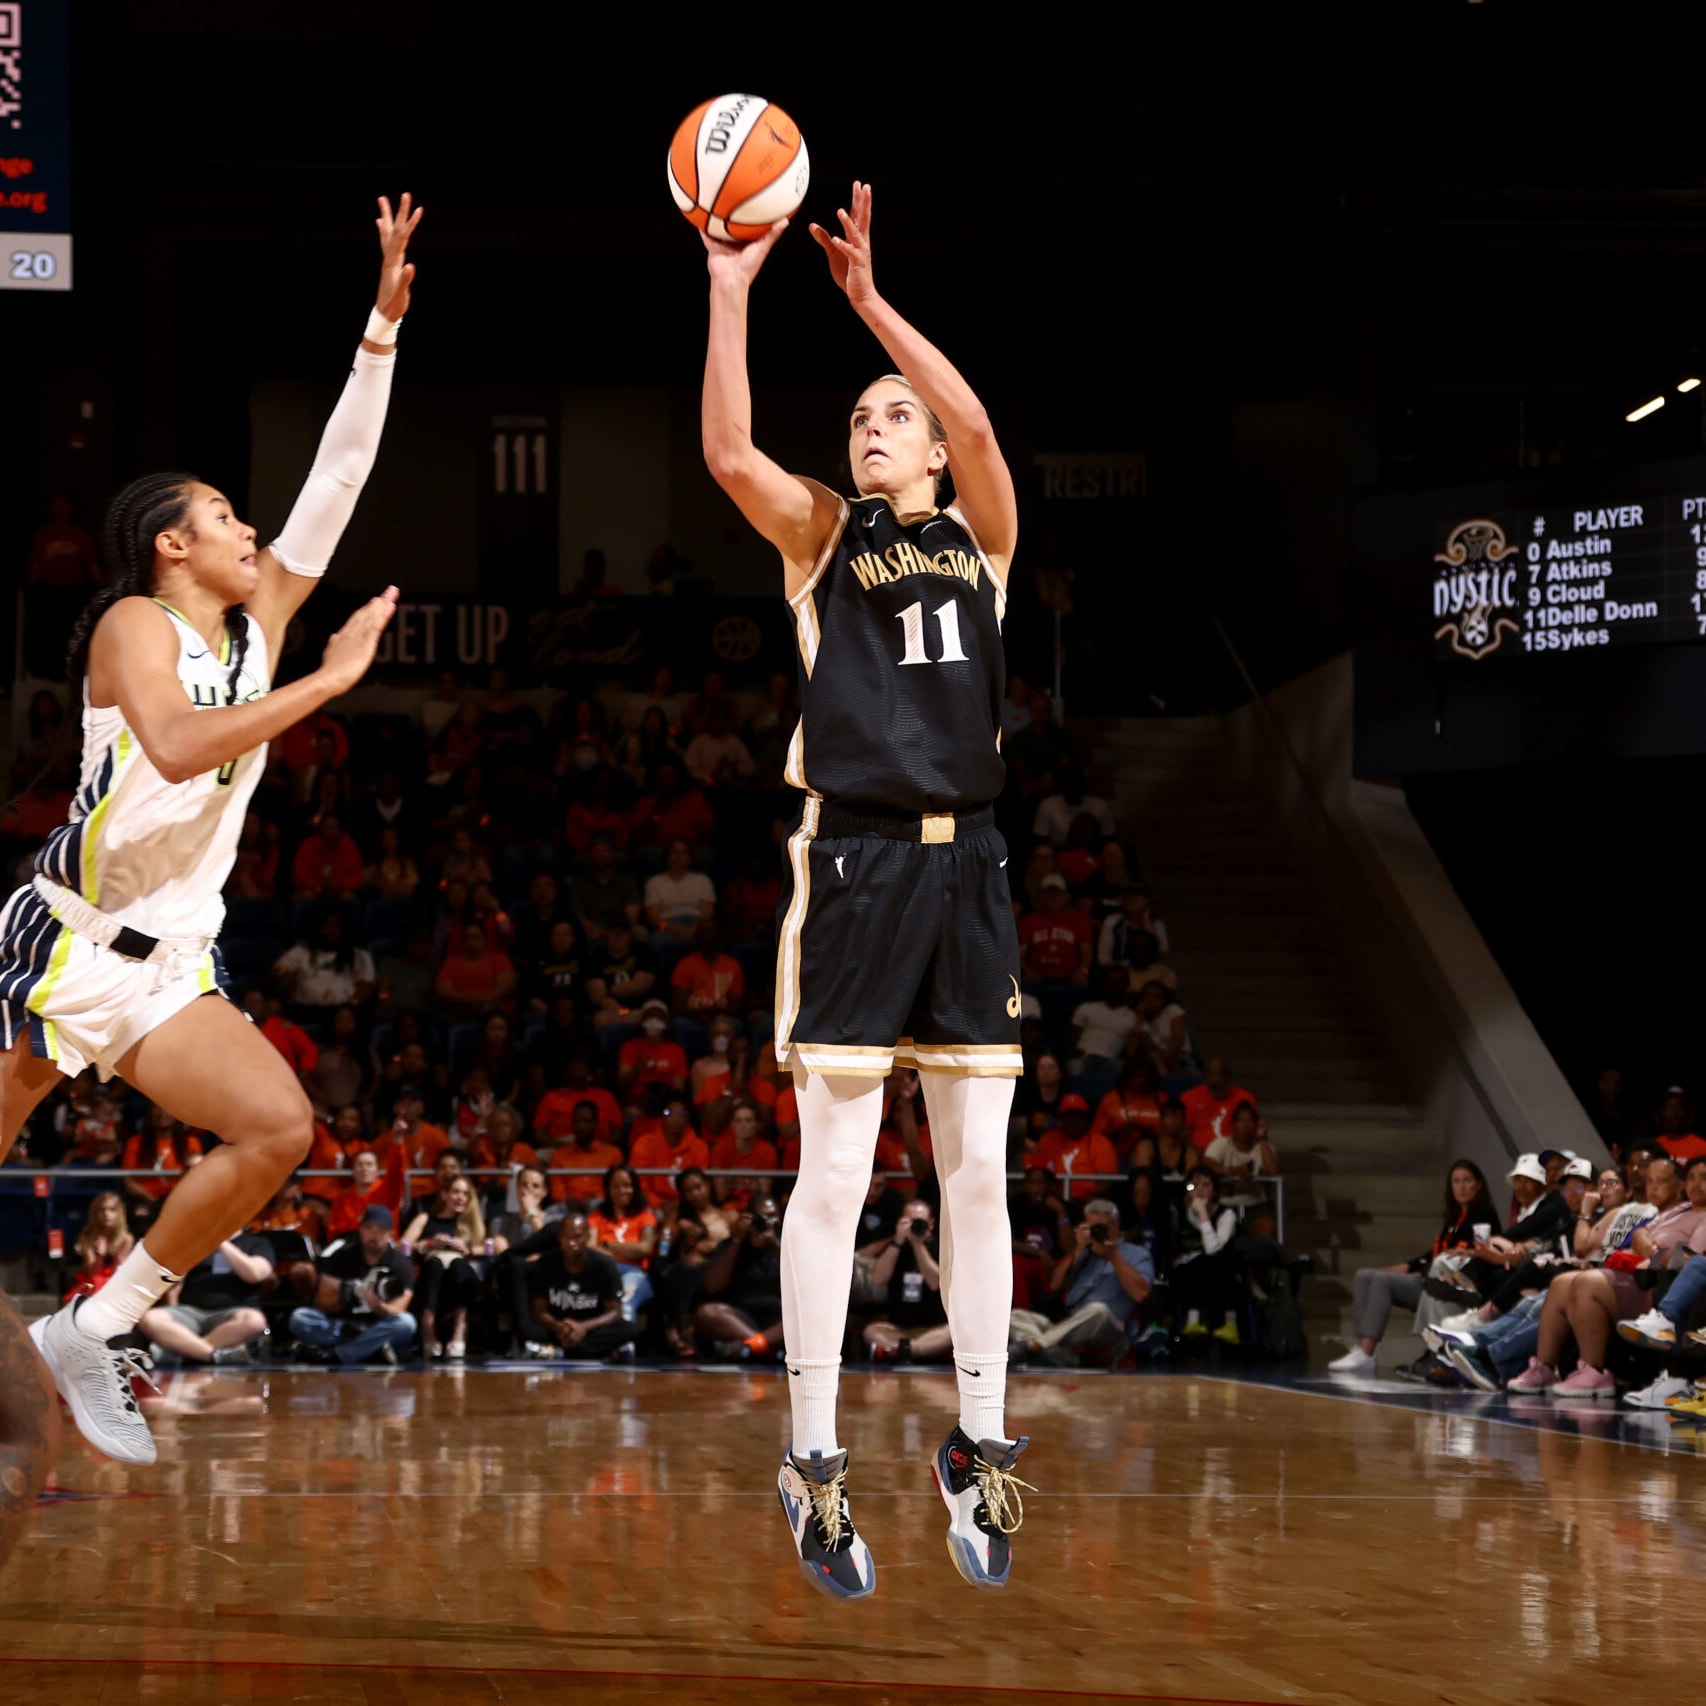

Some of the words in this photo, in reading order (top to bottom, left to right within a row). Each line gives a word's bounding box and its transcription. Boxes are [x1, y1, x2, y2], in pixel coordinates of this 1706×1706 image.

[10, 251, 55, 280] 20
[490, 432, 548, 495] 111
[1574, 505, 1644, 532] PLAYER
[1682, 497, 1706, 520] PT
[1527, 542, 1541, 562] 0
[1546, 535, 1612, 560] Austin
[1690, 523, 1706, 544] 1
[849, 542, 982, 592] WASHINGTON
[1528, 564, 1541, 584] 7
[1546, 559, 1613, 582] Atkins
[1528, 587, 1541, 607] 9
[1546, 579, 1606, 604] Cloud
[1604, 601, 1658, 622] Donn
[1690, 592, 1706, 613] 1
[456, 604, 511, 666] UP
[894, 599, 970, 666] 11
[1547, 626, 1610, 652] Sykes
